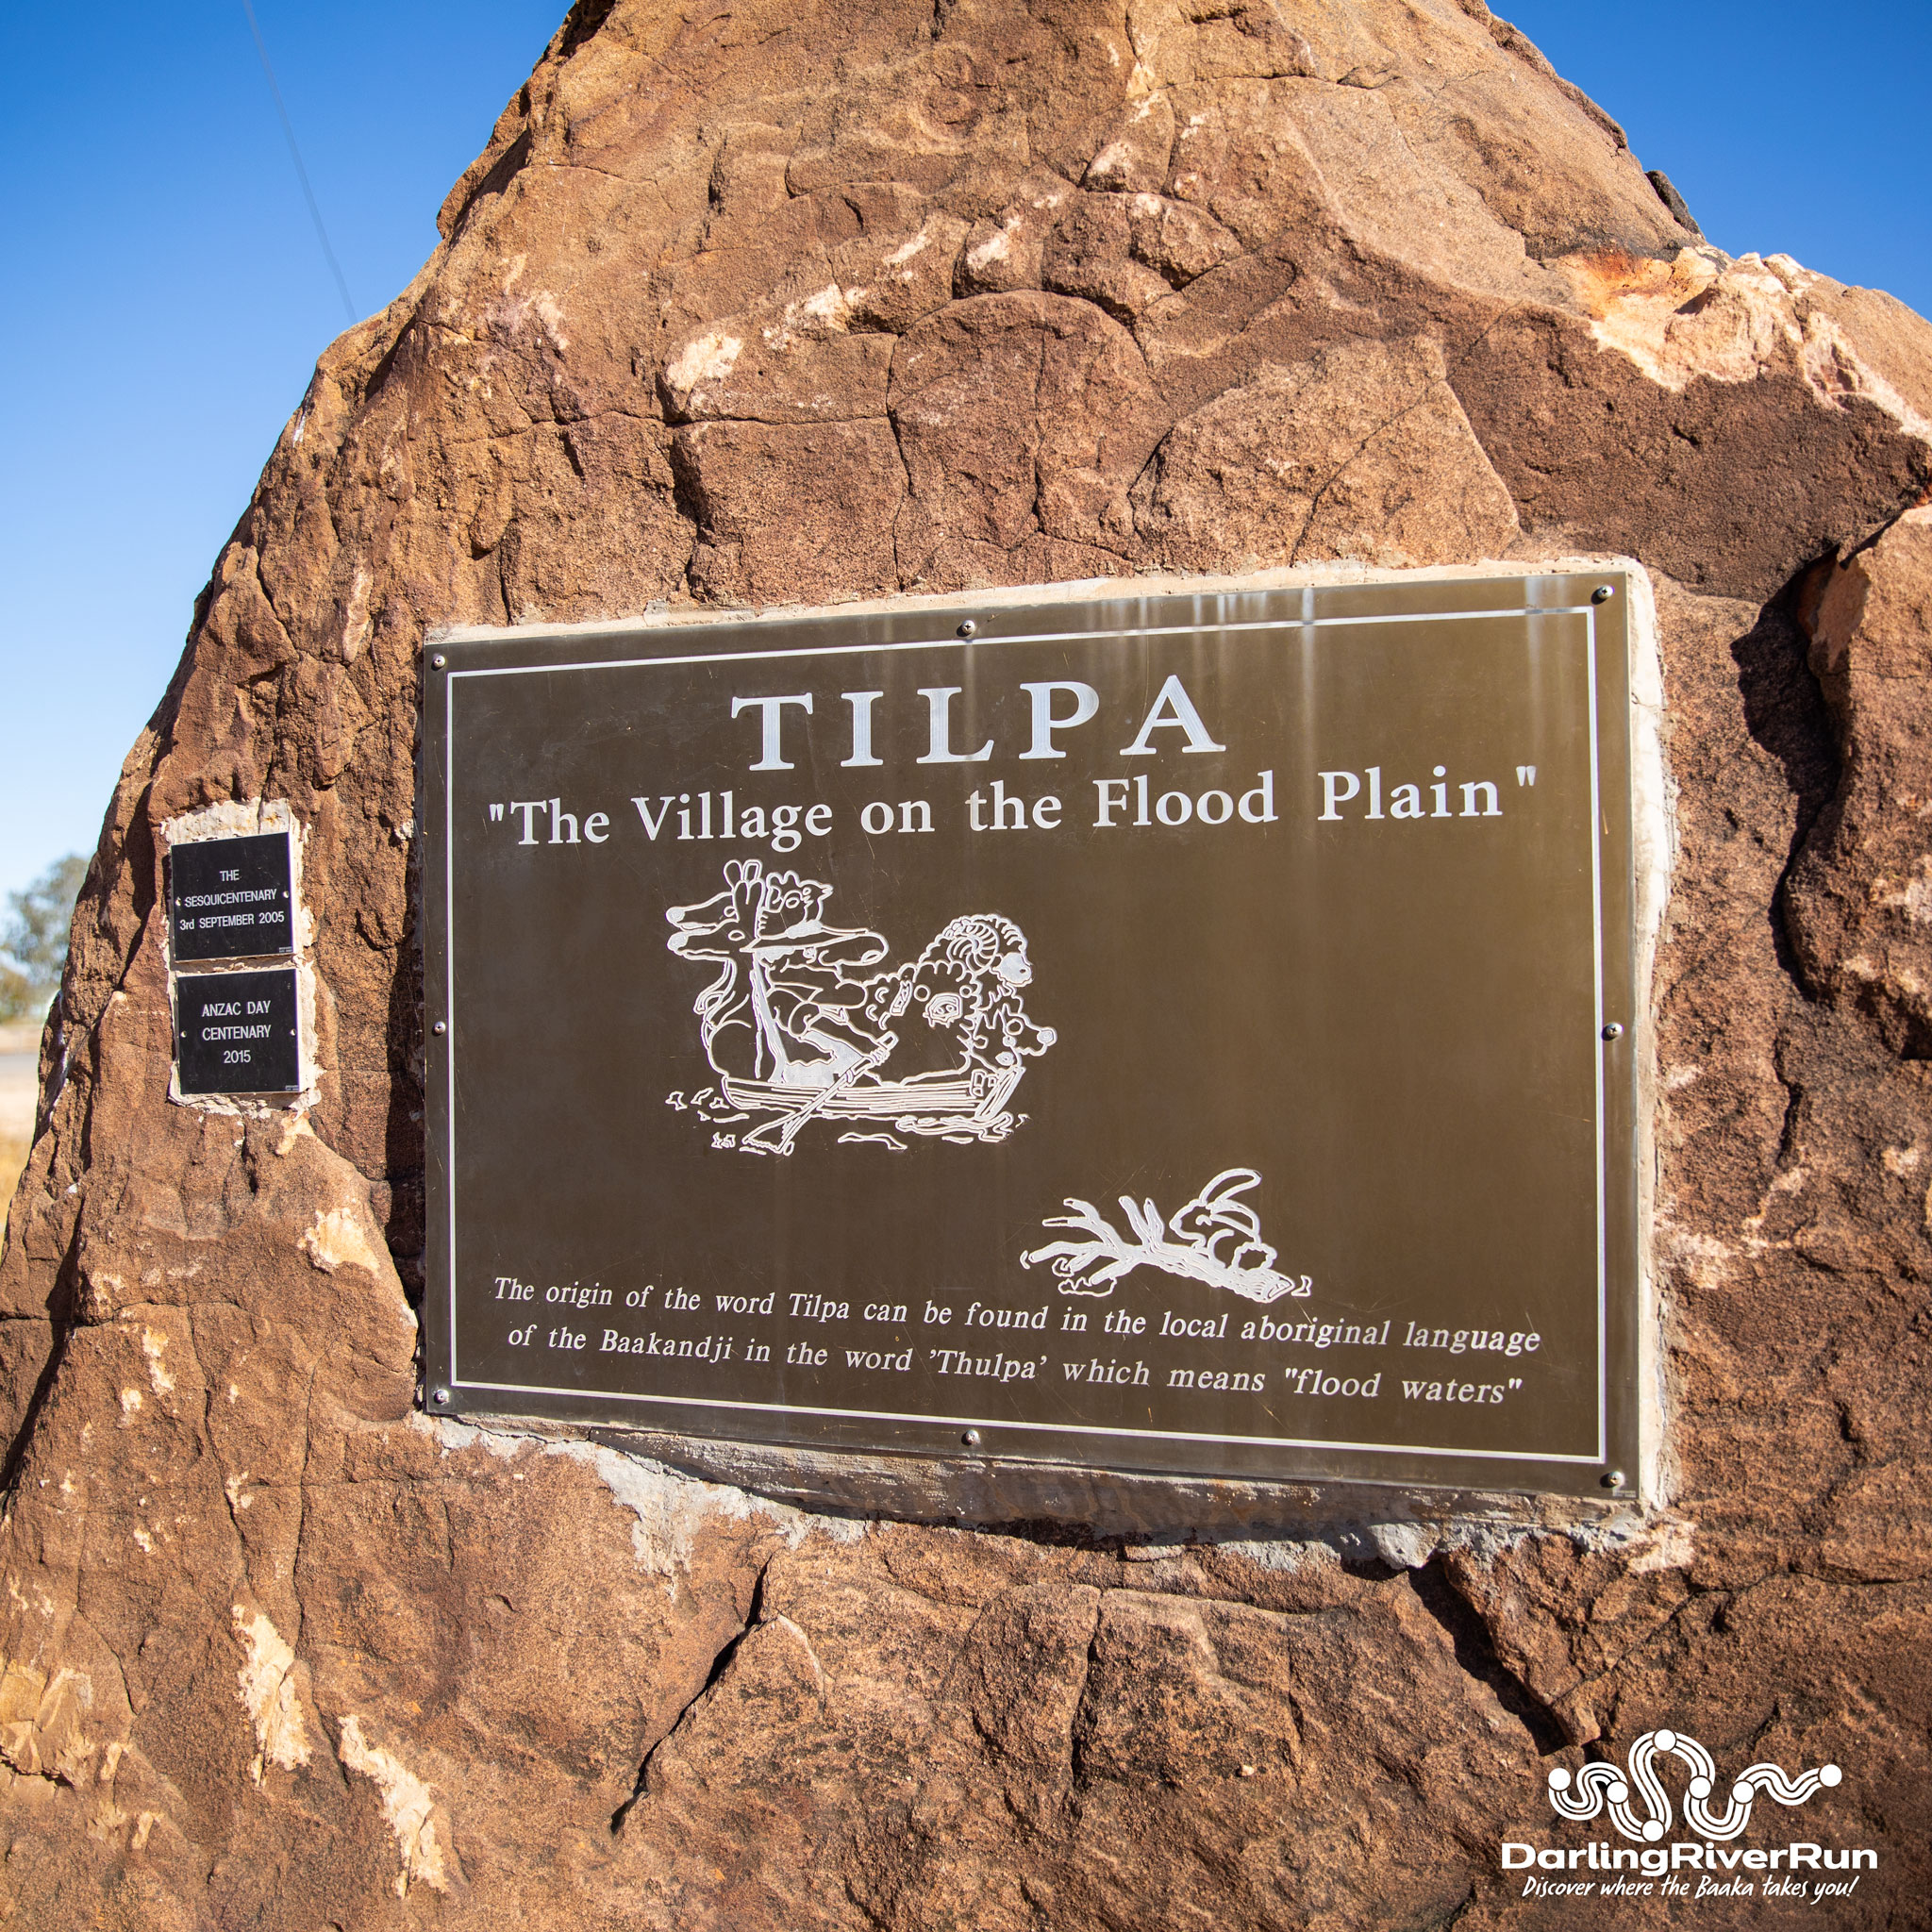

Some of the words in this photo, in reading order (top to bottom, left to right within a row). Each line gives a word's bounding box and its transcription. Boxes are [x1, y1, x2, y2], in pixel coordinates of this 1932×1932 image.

[730, 674, 1227, 772] TILPA
[489, 797, 610, 845] "The
[630, 790, 833, 853] Village
[860, 800, 936, 835] on
[964, 779, 1062, 832] the
[1092, 769, 1279, 827] Flood
[219, 869, 240, 882] THE
[184, 889, 277, 908] SESQUICENTENARY
[179, 918, 195, 931] 3rd
[199, 913, 255, 929] SEPTEMBER
[258, 910, 285, 924] 2005
[201, 1001, 242, 1017] ANZAC
[247, 1000, 272, 1015] DAY
[202, 1024, 272, 1041] CENTENARY
[223, 1049, 252, 1064] 2015
[494, 1276, 535, 1301] The
[545, 1280, 613, 1309] origin
[625, 1285, 655, 1307] of
[664, 1287, 701, 1310] the
[715, 1291, 775, 1315] word
[789, 1292, 850, 1323] Tilpa
[863, 1303, 908, 1323] can
[923, 1300, 952, 1324] be
[964, 1302, 1049, 1329] found
[1059, 1306, 1088, 1332] in
[1104, 1308, 1146, 1335] the
[1158, 1310, 1228, 1339] local
[1241, 1314, 1391, 1349] aboriginal
[1403, 1321, 1541, 1357] language
[508, 1324, 538, 1346] of
[548, 1326, 587, 1350] the
[598, 1329, 732, 1363] Baakandji
[744, 1338, 771, 1362] in
[787, 1341, 828, 1366] the
[845, 1348, 913, 1372] word
[1062, 1357, 1150, 1385] which
[1166, 1369, 1266, 1391] means
[1285, 1367, 1381, 1397] "flood
[1402, 1377, 1523, 1404] waters"
